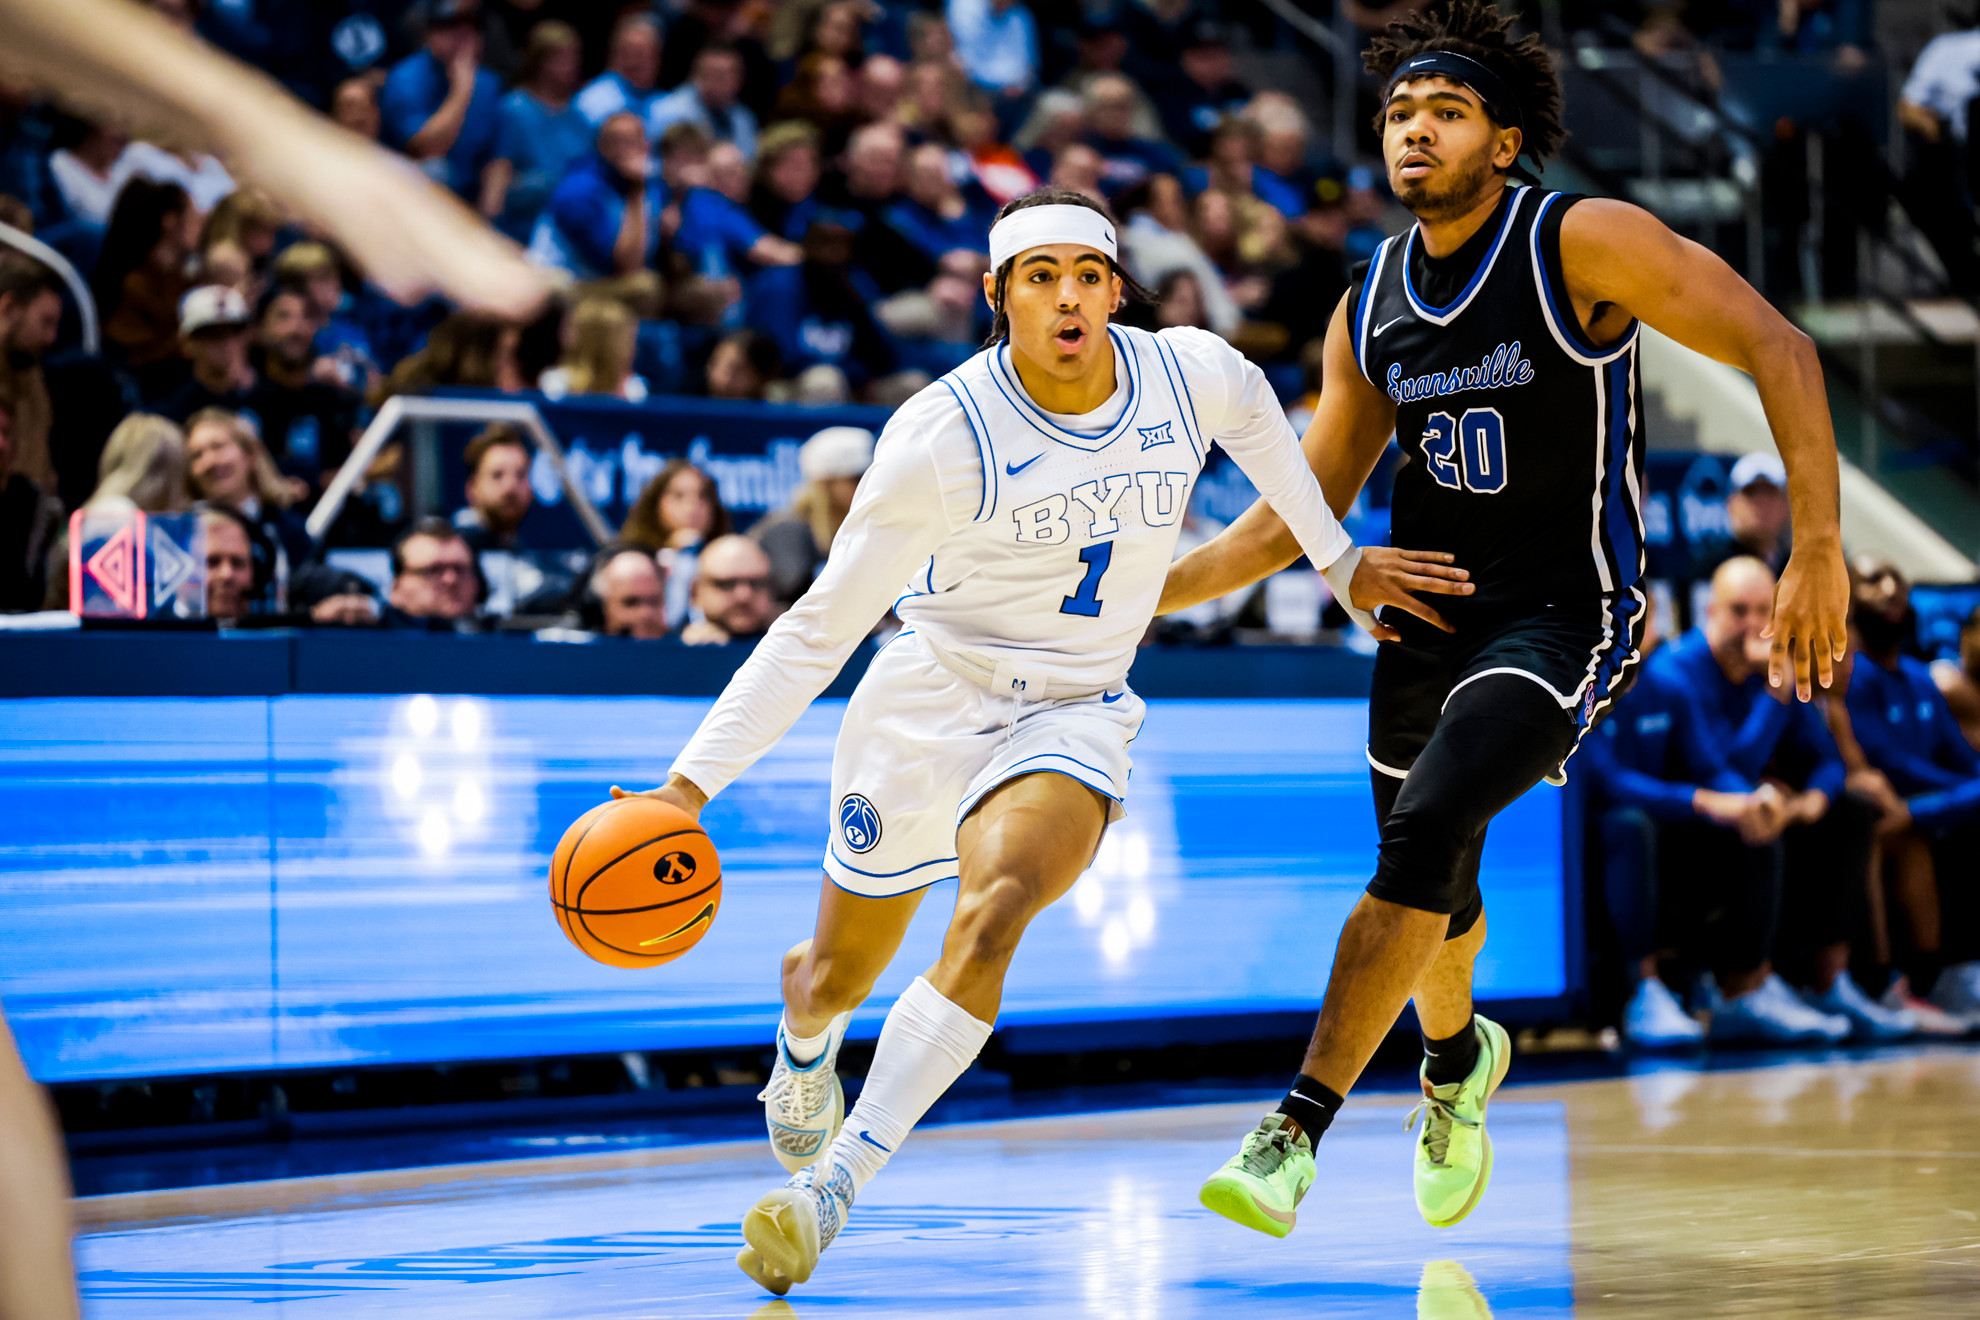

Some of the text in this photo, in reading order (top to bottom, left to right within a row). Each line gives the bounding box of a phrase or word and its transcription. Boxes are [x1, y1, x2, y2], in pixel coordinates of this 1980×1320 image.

[1387, 341, 1534, 405] Evansville
[1420, 407, 1508, 494] 20
[1012, 471, 1188, 545] BYU
[1059, 540, 1114, 618] 1
